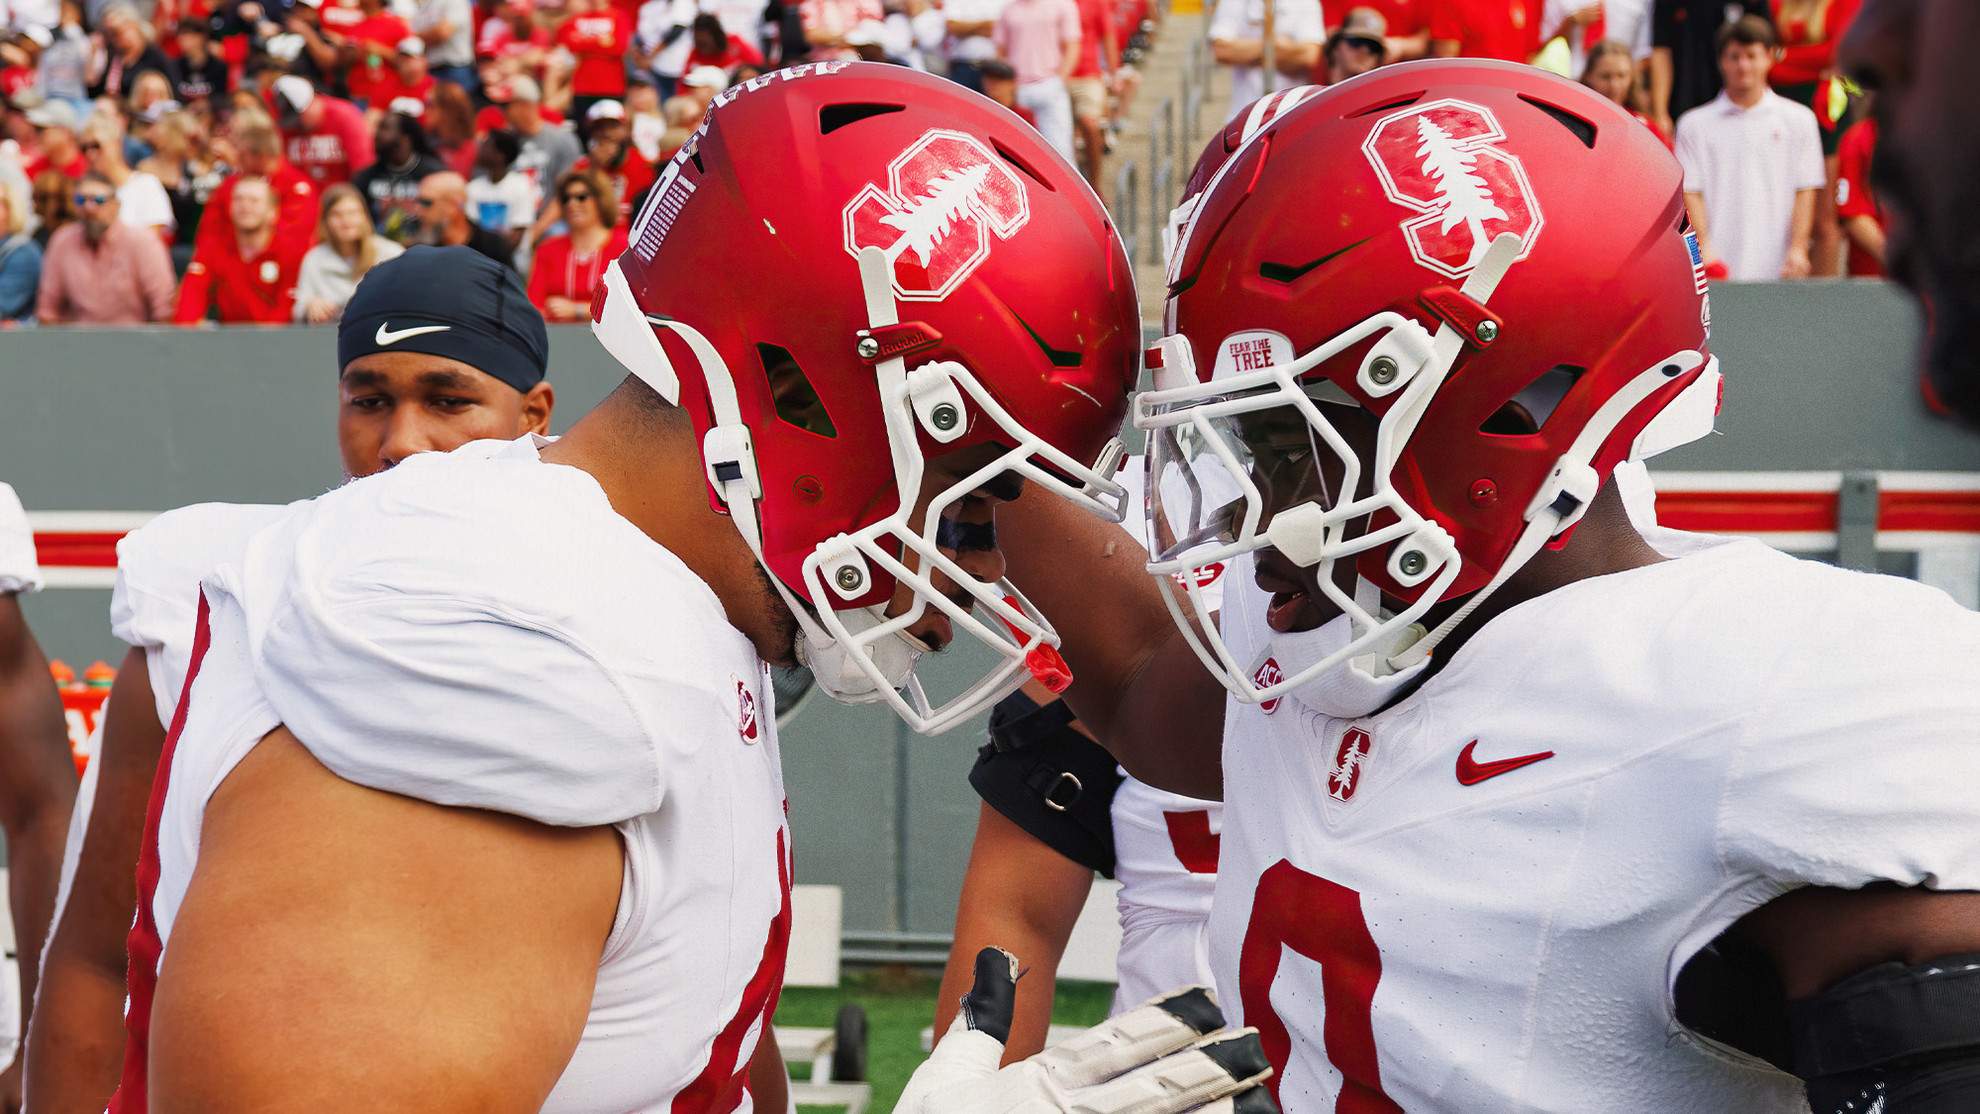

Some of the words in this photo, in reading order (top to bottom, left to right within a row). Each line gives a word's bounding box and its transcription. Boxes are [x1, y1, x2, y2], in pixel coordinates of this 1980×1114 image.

[1229, 341, 1251, 355] FEAR
[1252, 338, 1271, 351] THE
[1232, 349, 1275, 372] TREE
